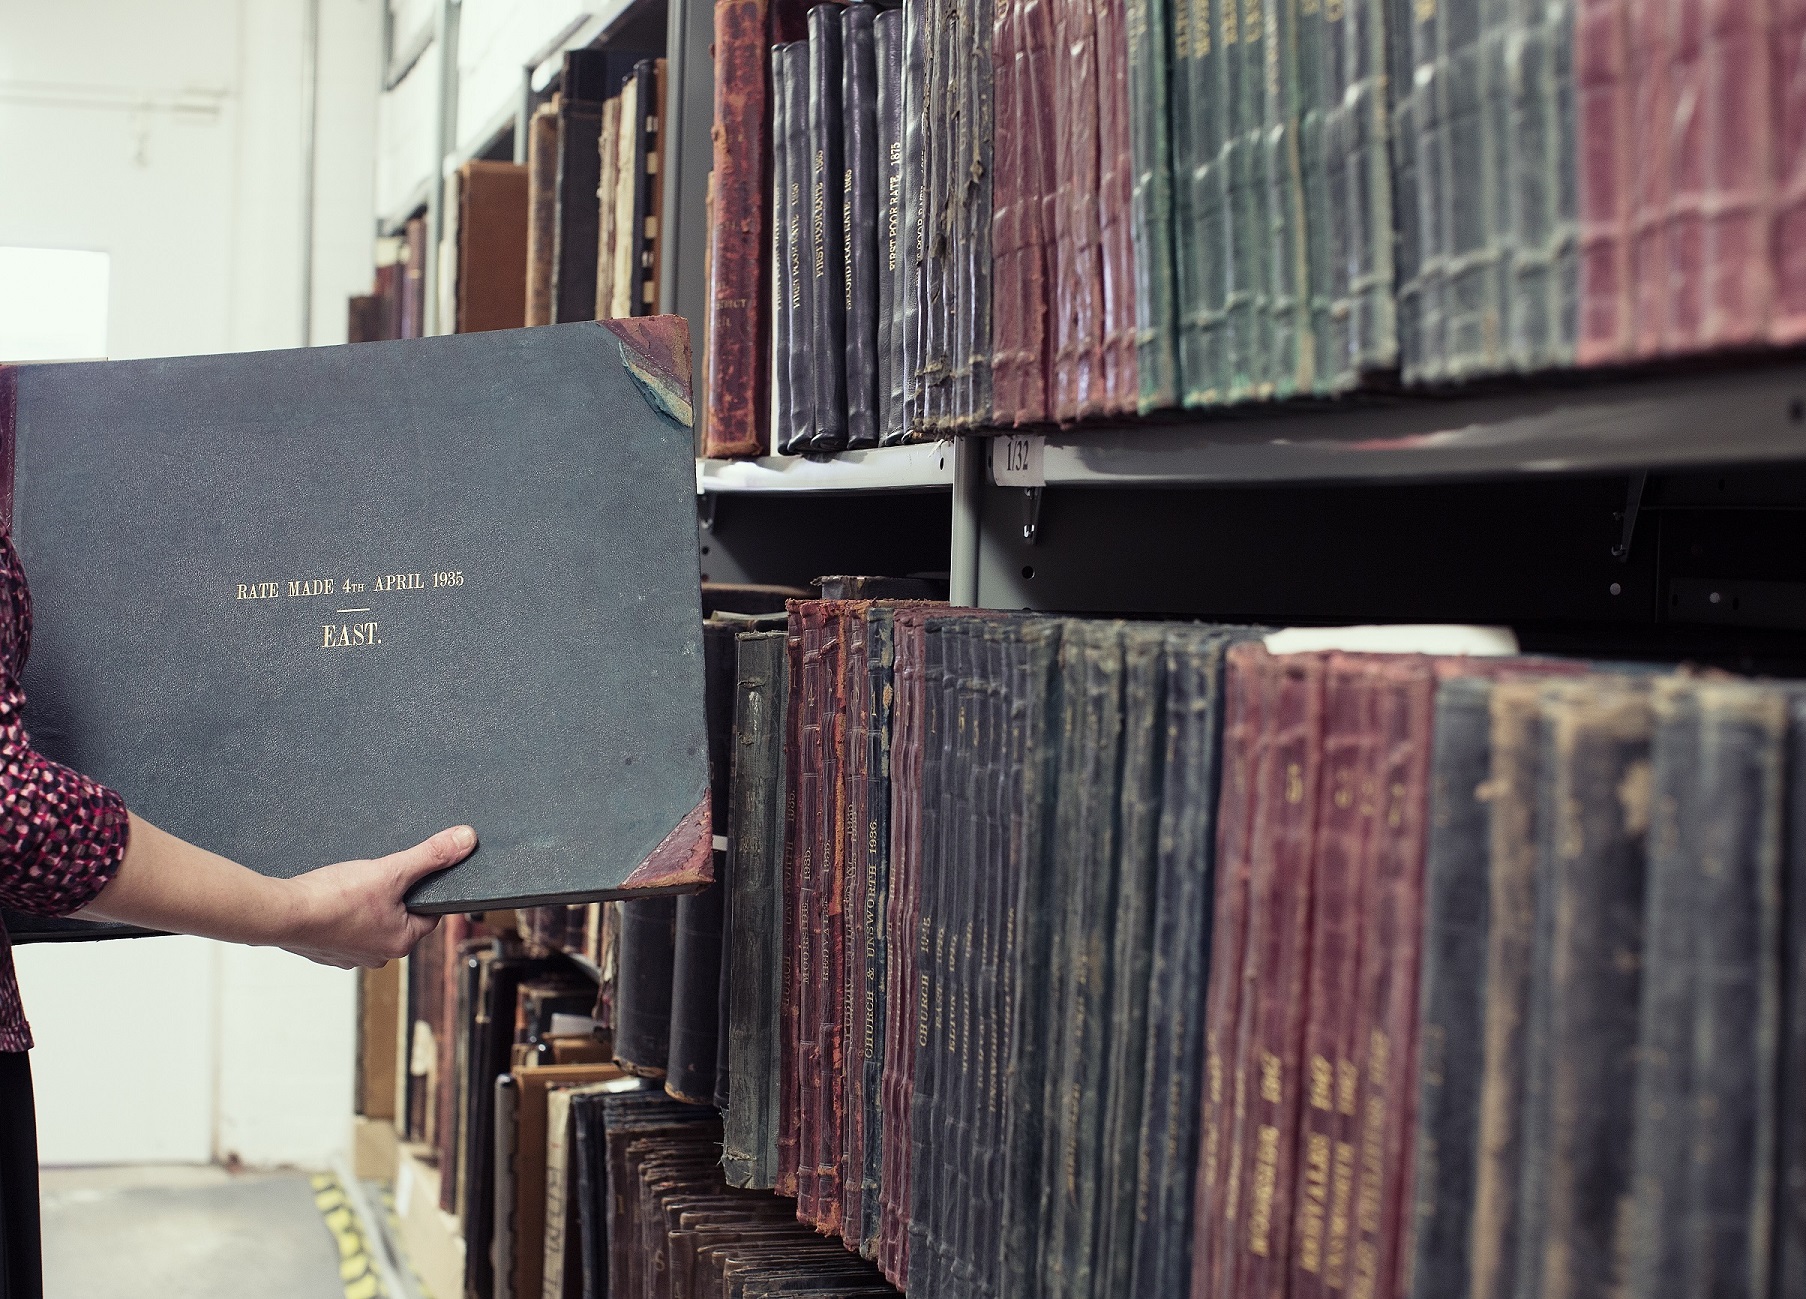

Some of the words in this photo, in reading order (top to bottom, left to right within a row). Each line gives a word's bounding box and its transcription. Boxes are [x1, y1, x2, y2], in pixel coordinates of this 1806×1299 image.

[890, 141, 901, 166] 1875
[889, 175, 900, 206] RATE
[814, 213, 824, 244] POOR
[889, 206, 899, 238] POOR
[815, 245, 824, 277] FIRST
[889, 237, 897, 272] FIRST
[1006, 440, 1029, 471] 1/32
[236, 582, 279, 600] RATE
[287, 578, 334, 597] MADE
[342, 578, 365, 593] 4TH
[373, 573, 425, 592] APRIL
[432, 570, 465, 588] 1935
[321, 622, 382, 648] EAST.
[865, 862, 877, 958] UNSWORTH
[866, 966, 875, 981] &
[864, 990, 874, 1060] CHURCH
[918, 973, 930, 1047] CHURCH
